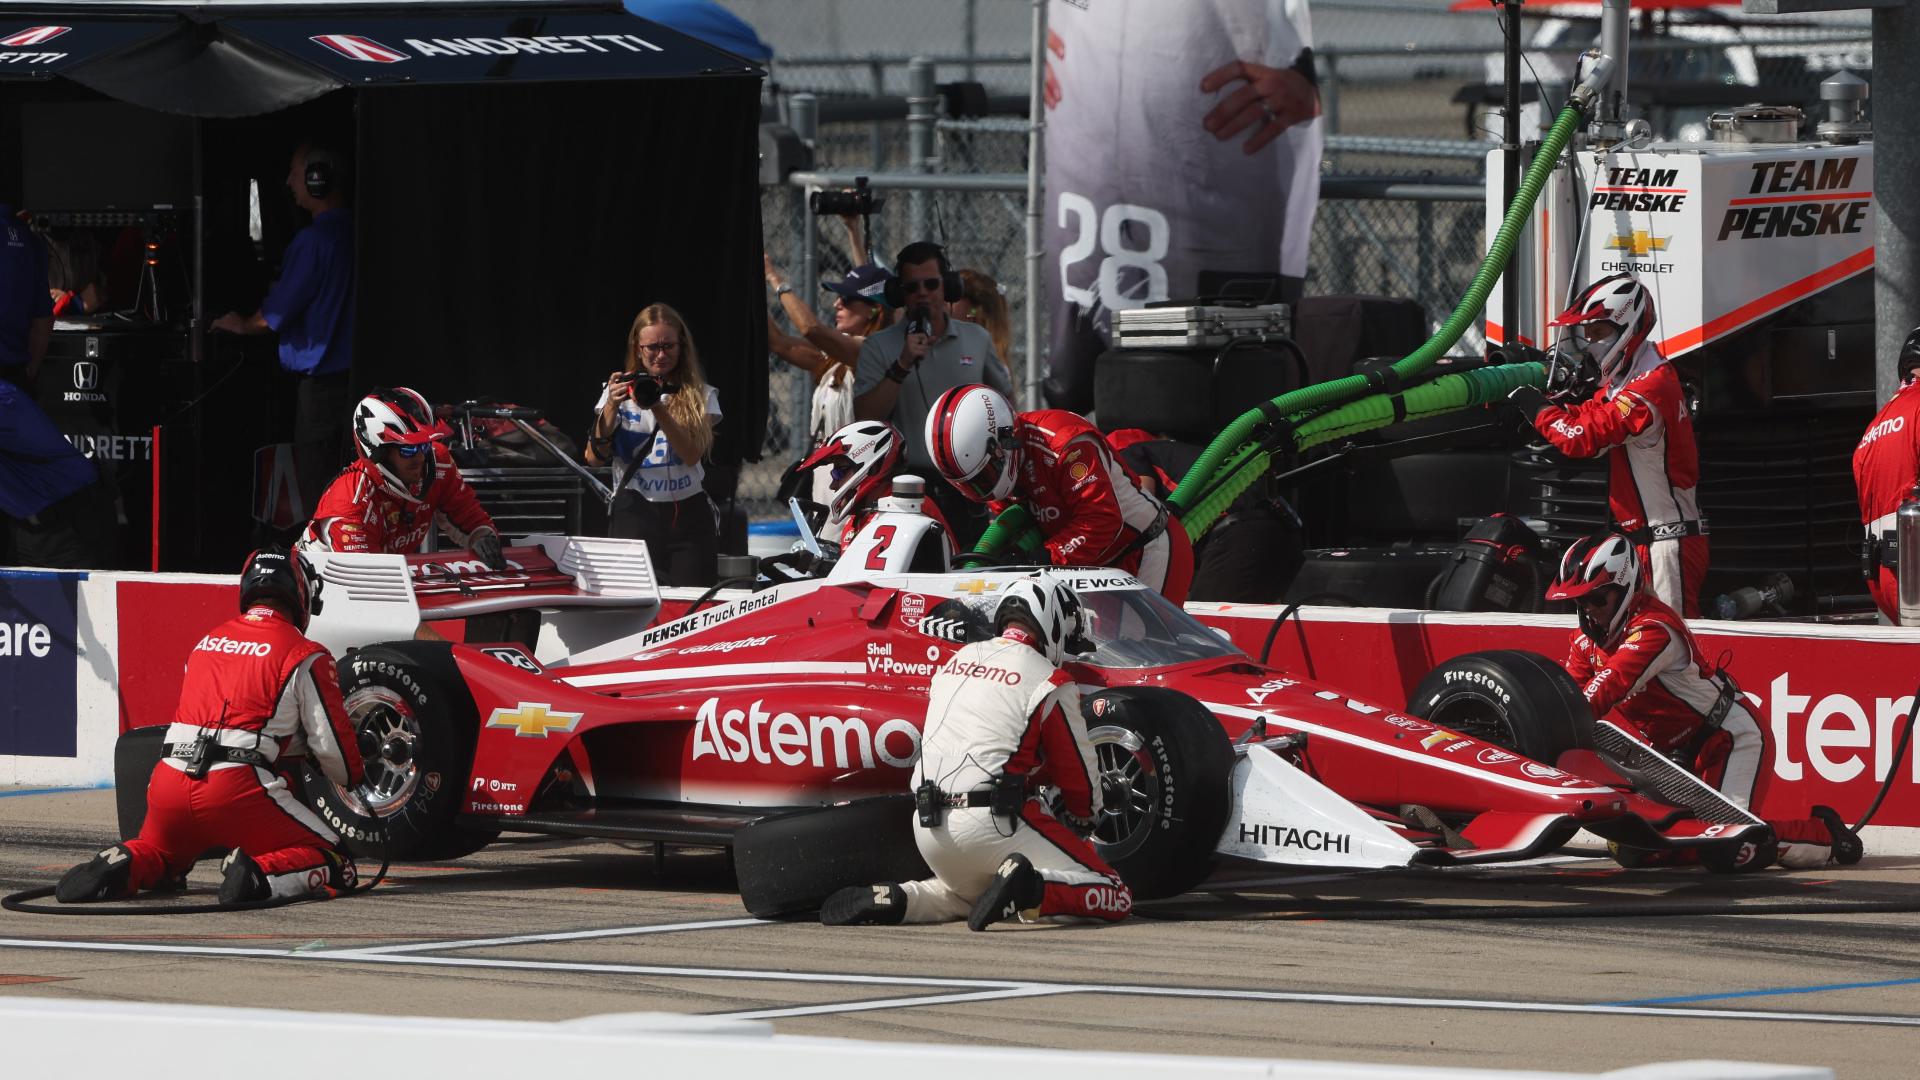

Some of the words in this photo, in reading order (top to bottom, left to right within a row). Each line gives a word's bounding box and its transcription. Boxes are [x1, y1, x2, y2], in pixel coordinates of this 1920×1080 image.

[404, 35, 664, 57] ANDRETTI
[1608, 167, 1679, 187] TEAM
[1749, 157, 1859, 194] TEAM
[1590, 192, 1686, 213] PENSKE
[1717, 201, 1870, 241] PENSKE
[1058, 191, 1170, 311] 28
[1601, 261, 1675, 274] CHEVROLET
[63, 391, 108, 401] HONDA
[982, 394, 997, 435] Astemo
[851, 440, 876, 460] Astemo
[256, 553, 286, 561] Astemo
[864, 524, 897, 571] 2
[642, 616, 699, 647] PENSKE
[702, 604, 735, 627] Truck
[738, 589, 778, 615] Rental
[0, 621, 51, 658] are
[192, 634, 272, 657] Astemo
[678, 634, 777, 656] Gallagher
[866, 642, 892, 656] Shell
[867, 656, 934, 676] V-Power
[942, 658, 1022, 687] Astemo
[352, 659, 428, 706] Firestone
[1443, 669, 1511, 705] Firestone
[692, 697, 923, 770] Astemo
[501, 782, 517, 791] NTT
[1152, 735, 1175, 830] Firestone
[316, 796, 392, 843] irestone
[472, 802, 524, 813] Firestone
[1239, 822, 1351, 854] HITACHI
